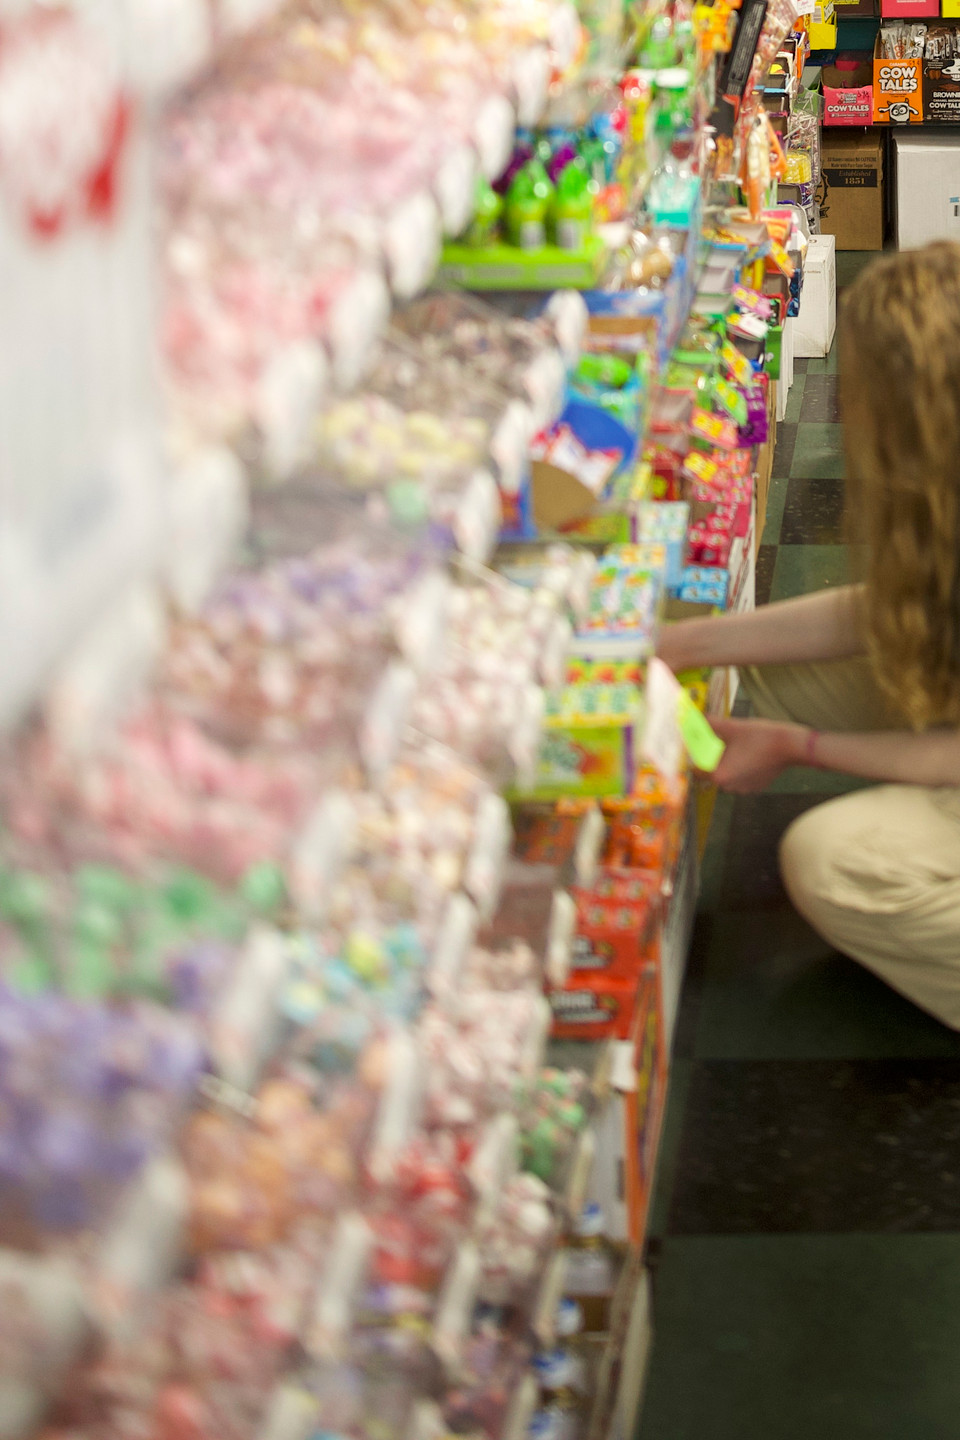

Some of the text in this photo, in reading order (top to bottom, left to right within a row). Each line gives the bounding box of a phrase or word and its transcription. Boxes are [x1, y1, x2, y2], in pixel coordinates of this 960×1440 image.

[880, 67, 916, 79] COW
[878, 79, 918, 91] TALES
[844, 177, 865, 185] 1851
